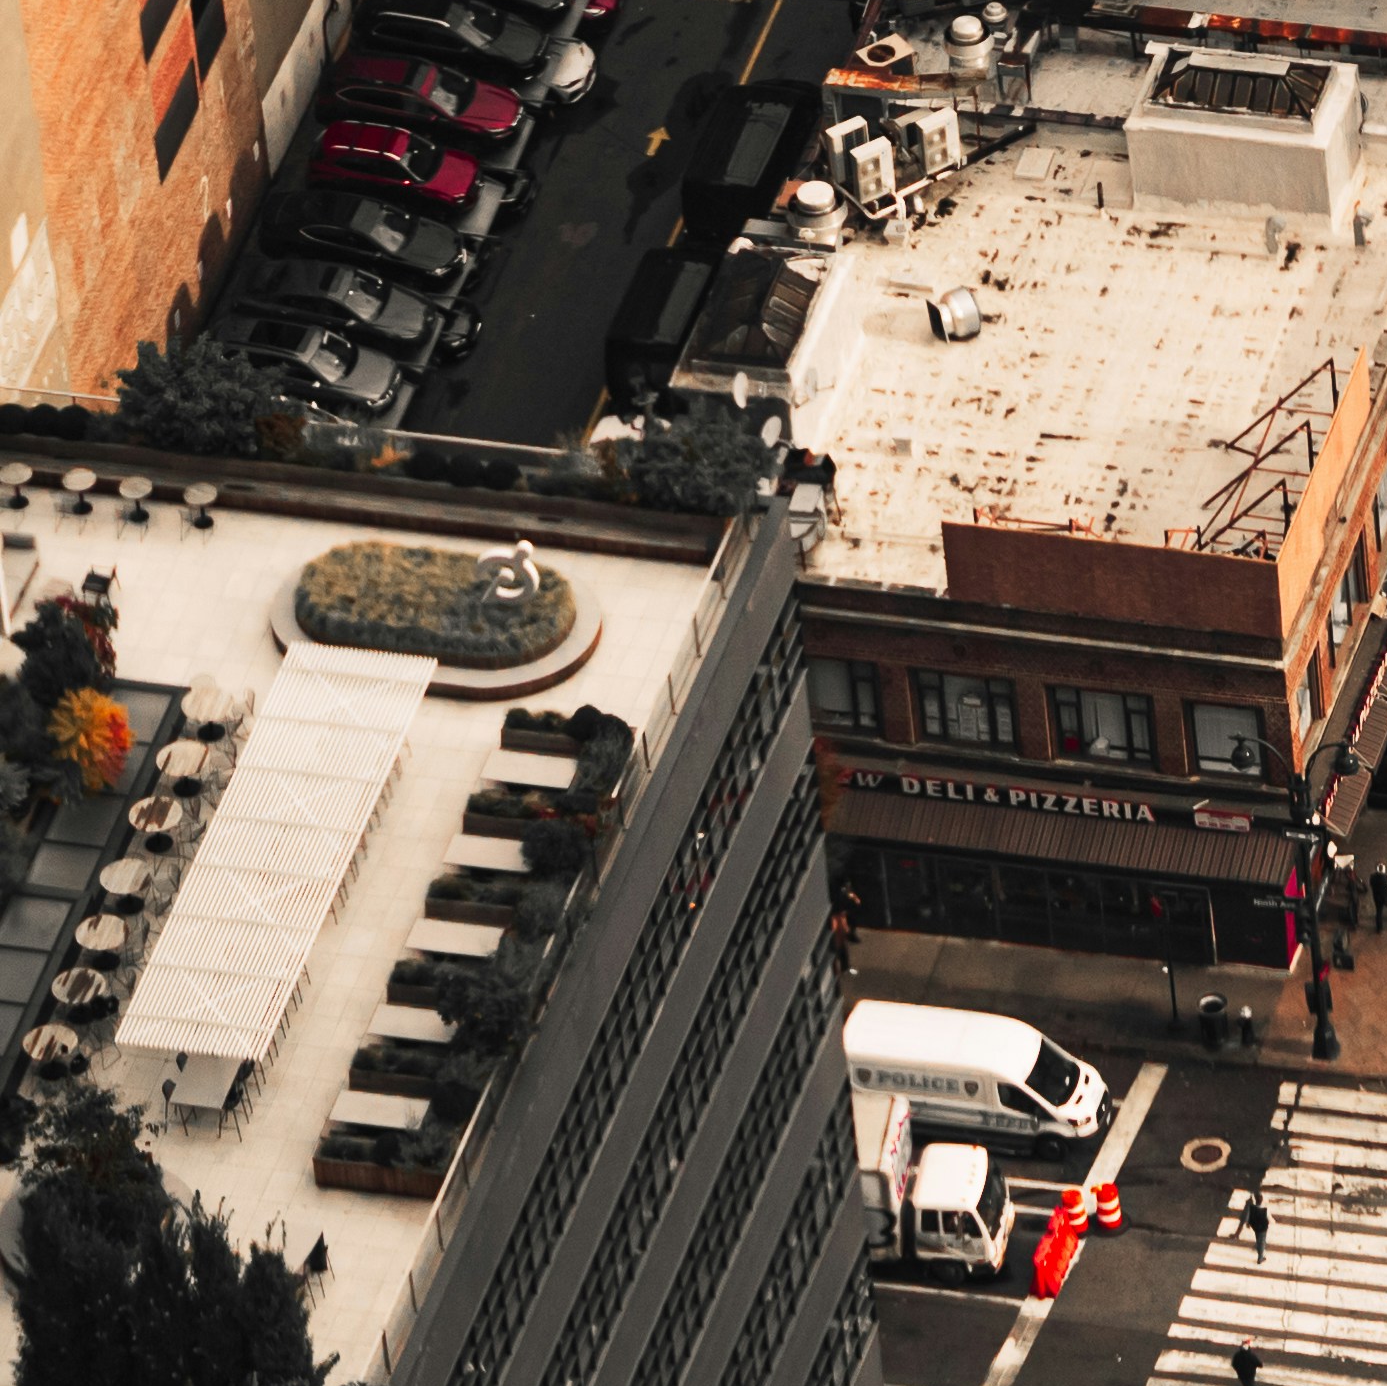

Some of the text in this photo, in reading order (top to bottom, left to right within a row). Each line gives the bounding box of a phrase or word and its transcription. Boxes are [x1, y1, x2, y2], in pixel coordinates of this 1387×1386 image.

[901, 774, 976, 802] DELI
[983, 787, 1000, 803] &
[1009, 787, 1157, 823] PIZZERIA
[876, 1069, 960, 1095] POLICE
